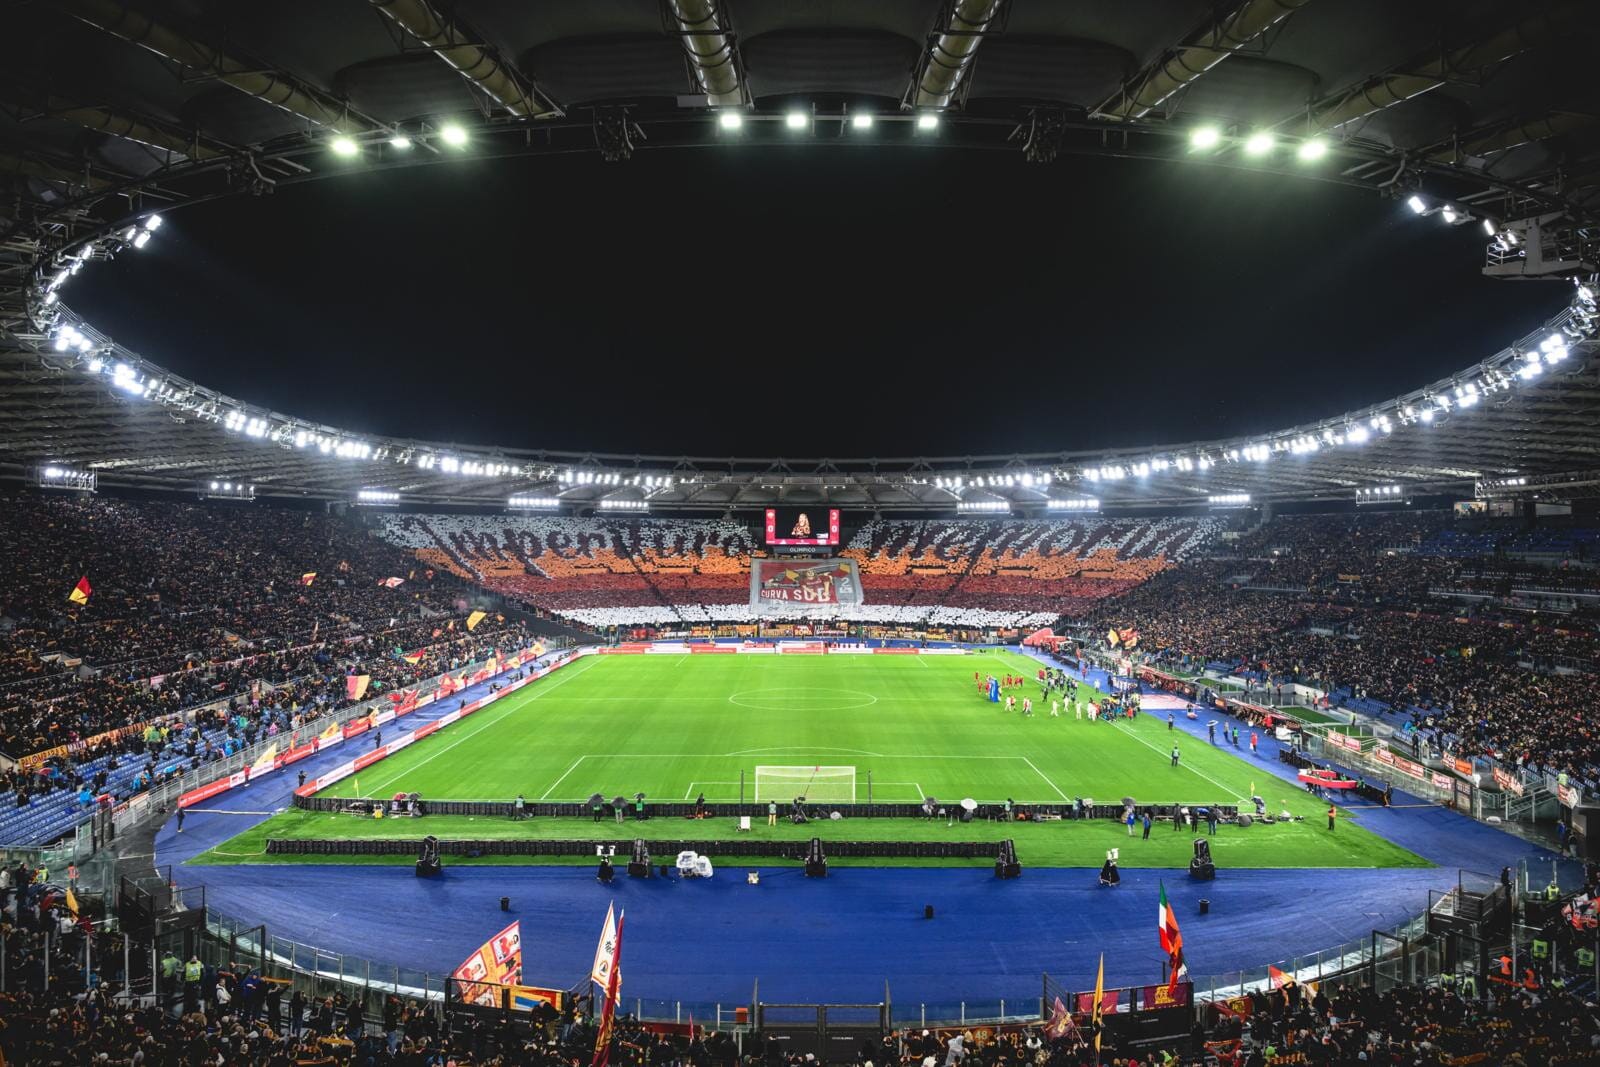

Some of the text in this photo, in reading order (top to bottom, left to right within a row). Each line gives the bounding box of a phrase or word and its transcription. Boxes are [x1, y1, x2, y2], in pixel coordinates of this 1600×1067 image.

[768, 525, 773, 533] 0
[831, 525, 837, 533] 0
[761, 589, 788, 600] CURVA
[793, 587, 830, 602] SUD
[67, 739, 87, 753] MALTA
